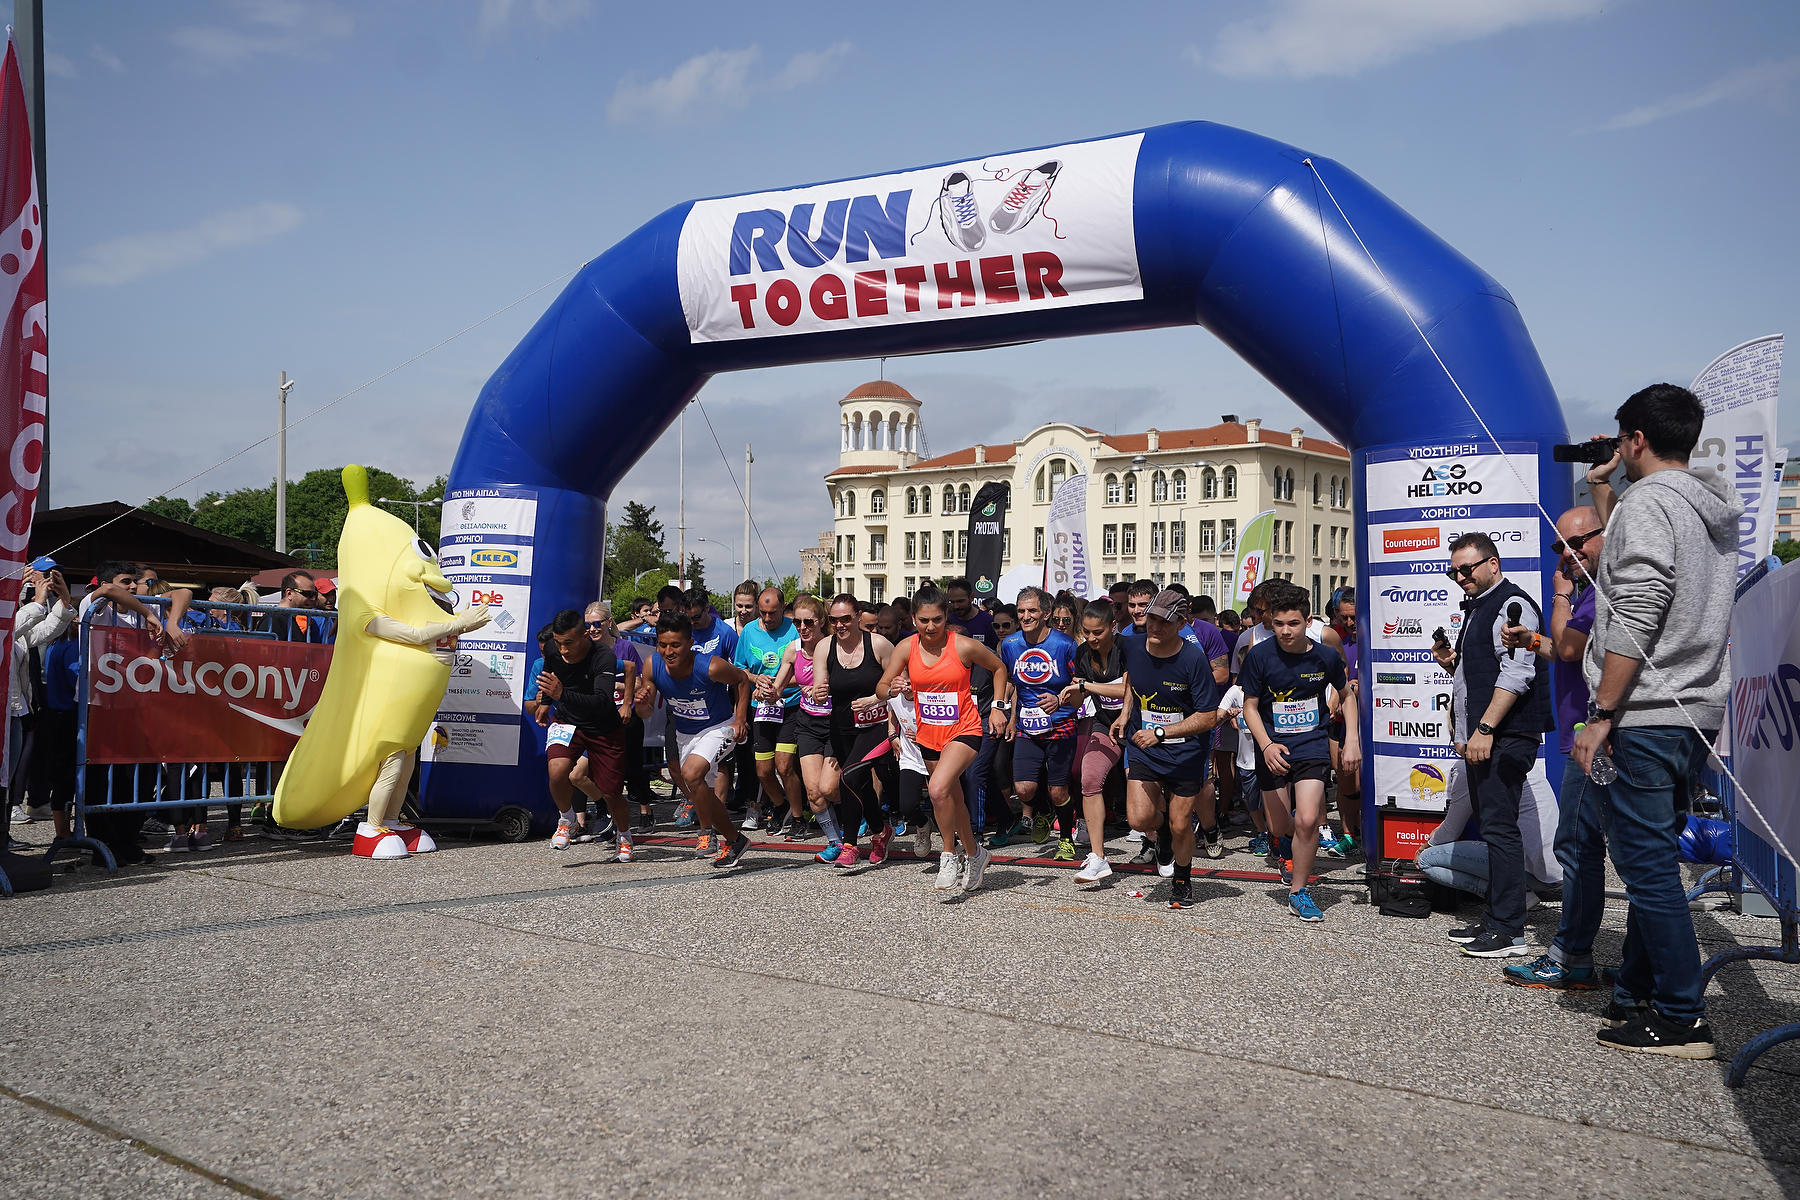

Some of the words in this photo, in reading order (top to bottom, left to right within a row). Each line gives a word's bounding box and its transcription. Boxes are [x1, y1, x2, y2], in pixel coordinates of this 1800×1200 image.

[729, 189, 913, 276] RUN
[730, 251, 1069, 329] TOGETHER
[1410, 444, 1478, 458] ΥΠΟΣΤΗΡΙΞΗ
[1408, 481, 1482, 498] HELEXPO
[1422, 507, 1470, 518] ΧΟΡΗΓΟΙ
[455, 535, 483, 543] ΧΟΡΗΓΟΙ
[1385, 537, 1436, 549] Counterpain
[476, 554, 512, 562] IKEA
[1054, 532, 1068, 584] 94.5
[1410, 563, 1451, 572] ΥΠΟΣΤΗ
[1242, 556, 1257, 592] Dole
[472, 590, 504, 604] Dole
[1390, 588, 1448, 602] avance
[457, 642, 507, 650] ΠΙΚΟΙΝΩΝΙΑΣ
[1391, 652, 1433, 662] ΧΟΡΗΓΟΙ
[758, 707, 781, 716] 6832
[858, 707, 885, 721] 6092
[923, 705, 954, 716] 6830
[1150, 704, 1182, 712] Running
[1023, 718, 1048, 728] 6718
[1278, 712, 1315, 725] 6080
